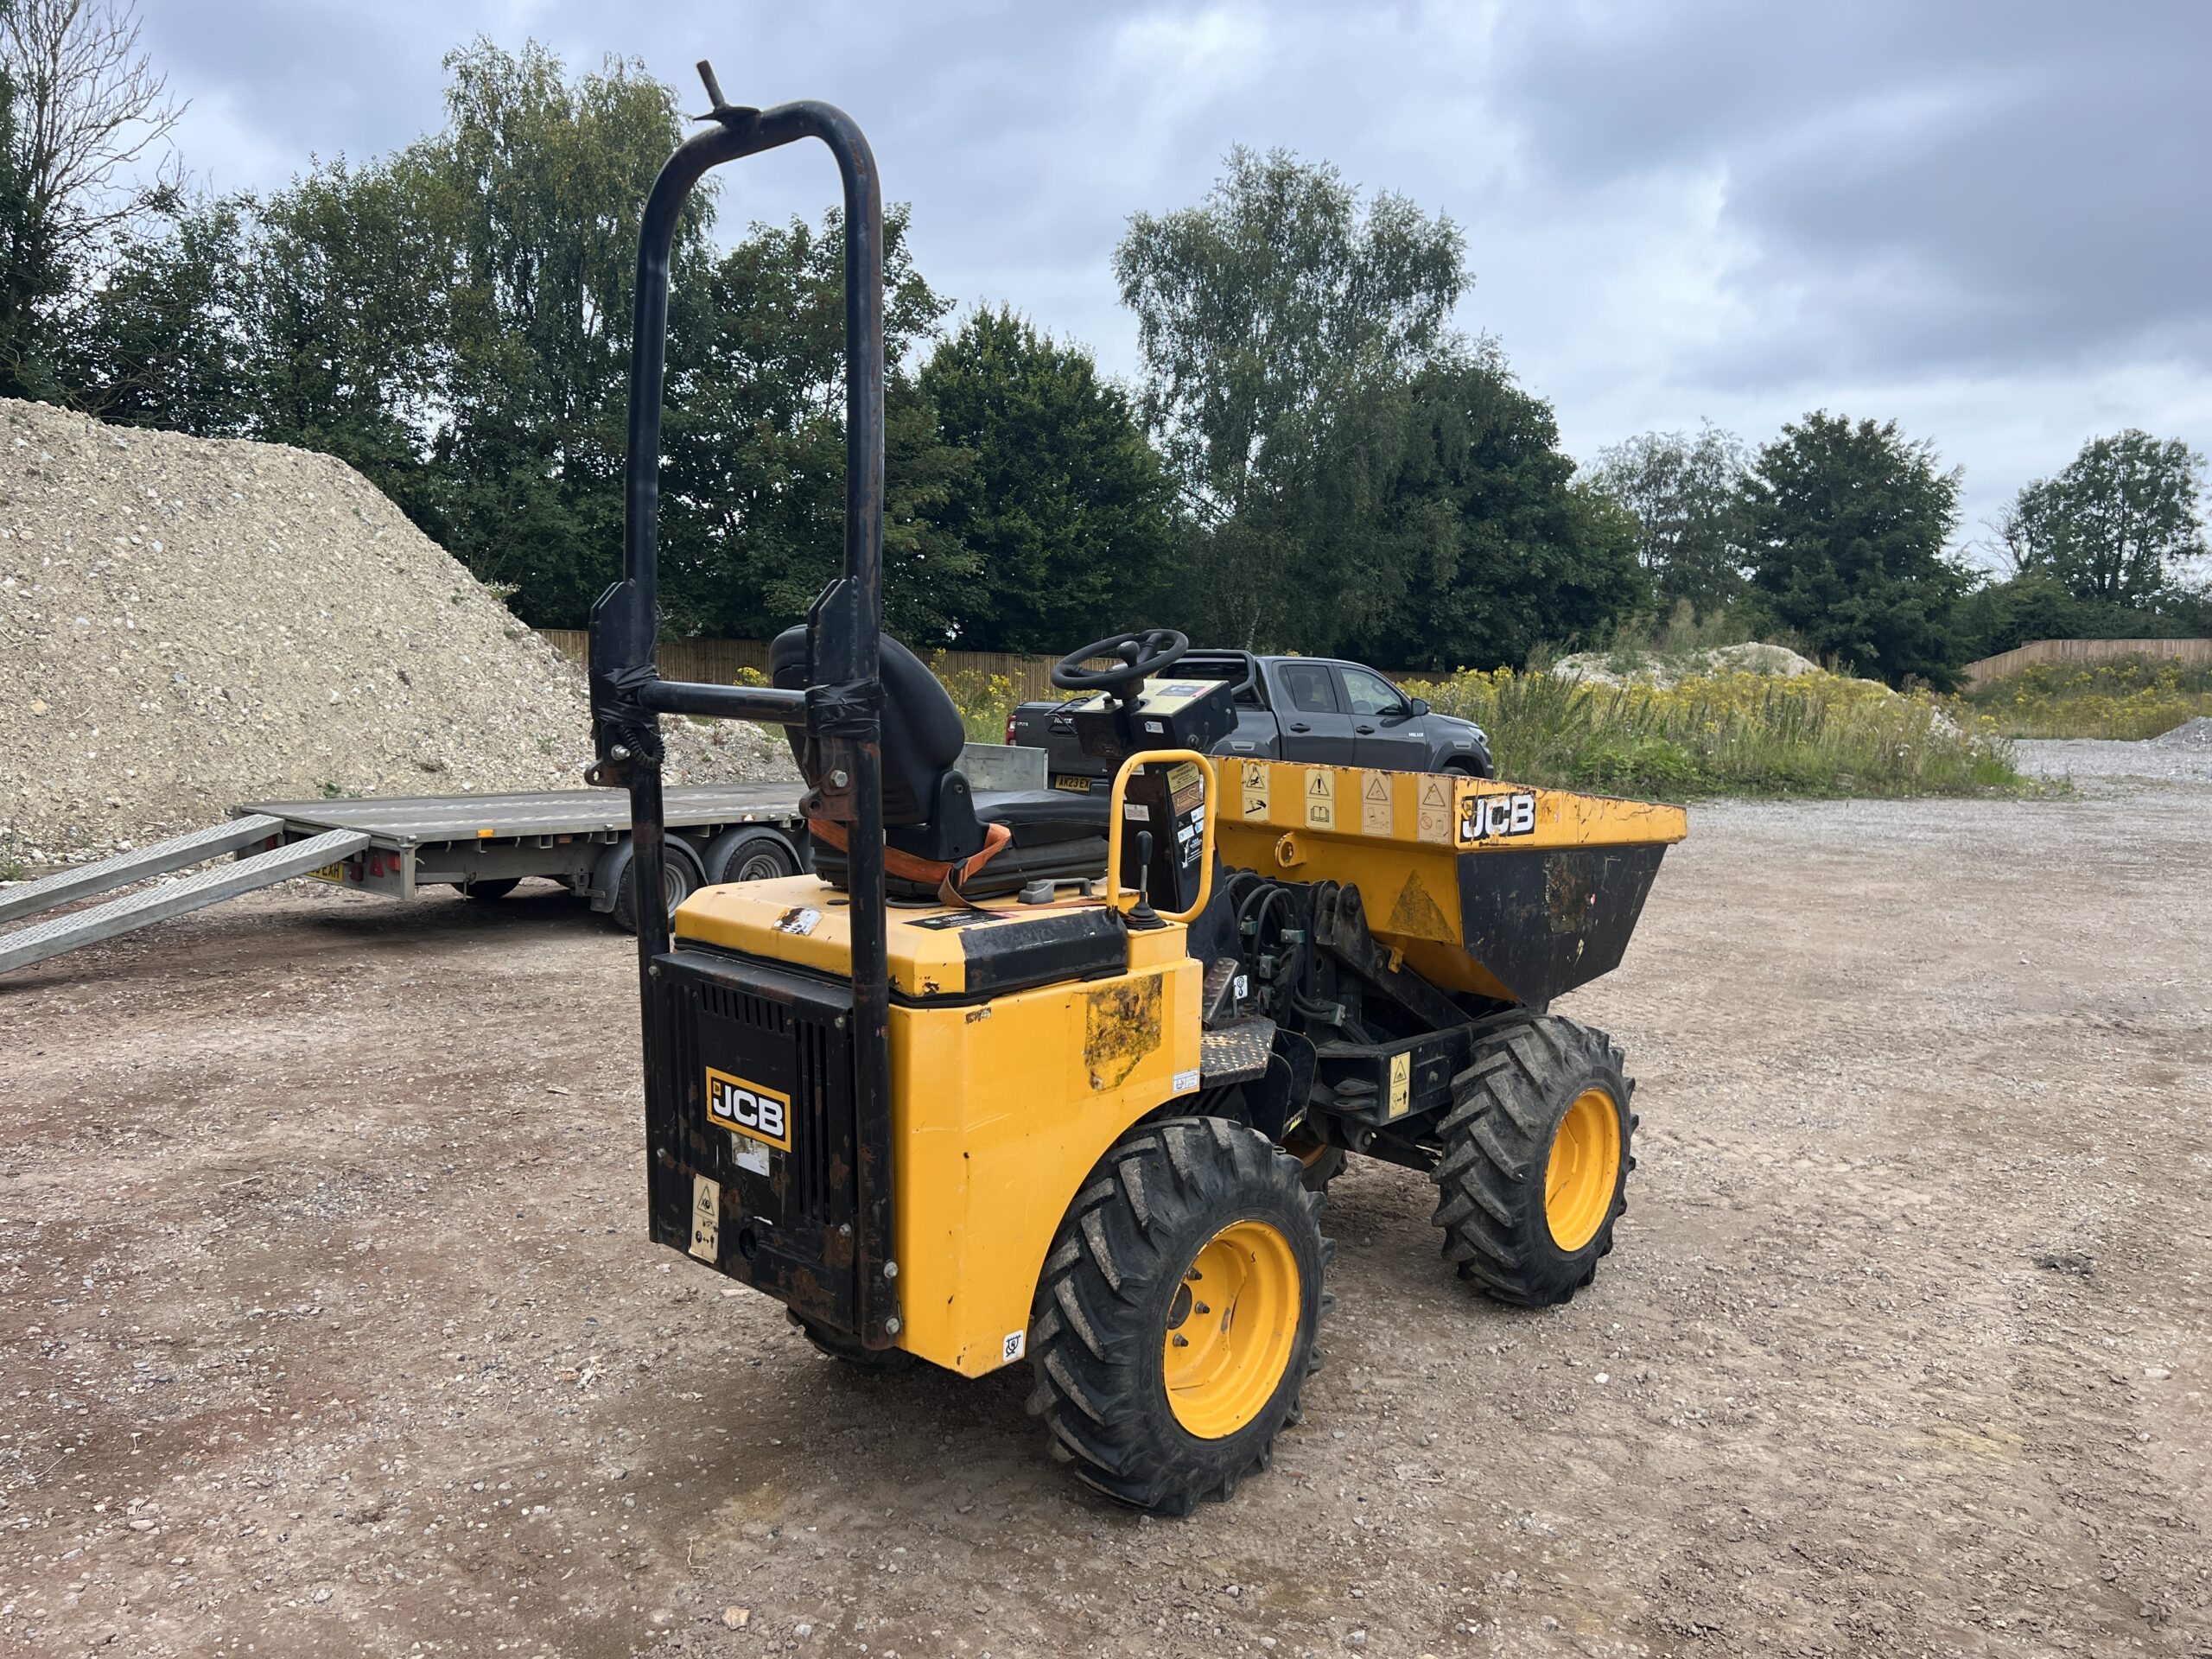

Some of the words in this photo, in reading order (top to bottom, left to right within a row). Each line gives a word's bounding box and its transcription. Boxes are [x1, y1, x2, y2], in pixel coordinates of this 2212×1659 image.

[1058, 777, 1079, 787] AK23
[1079, 778, 1090, 789] EX
[1462, 794, 1535, 838] JCB
[713, 1084, 784, 1136] JCB
